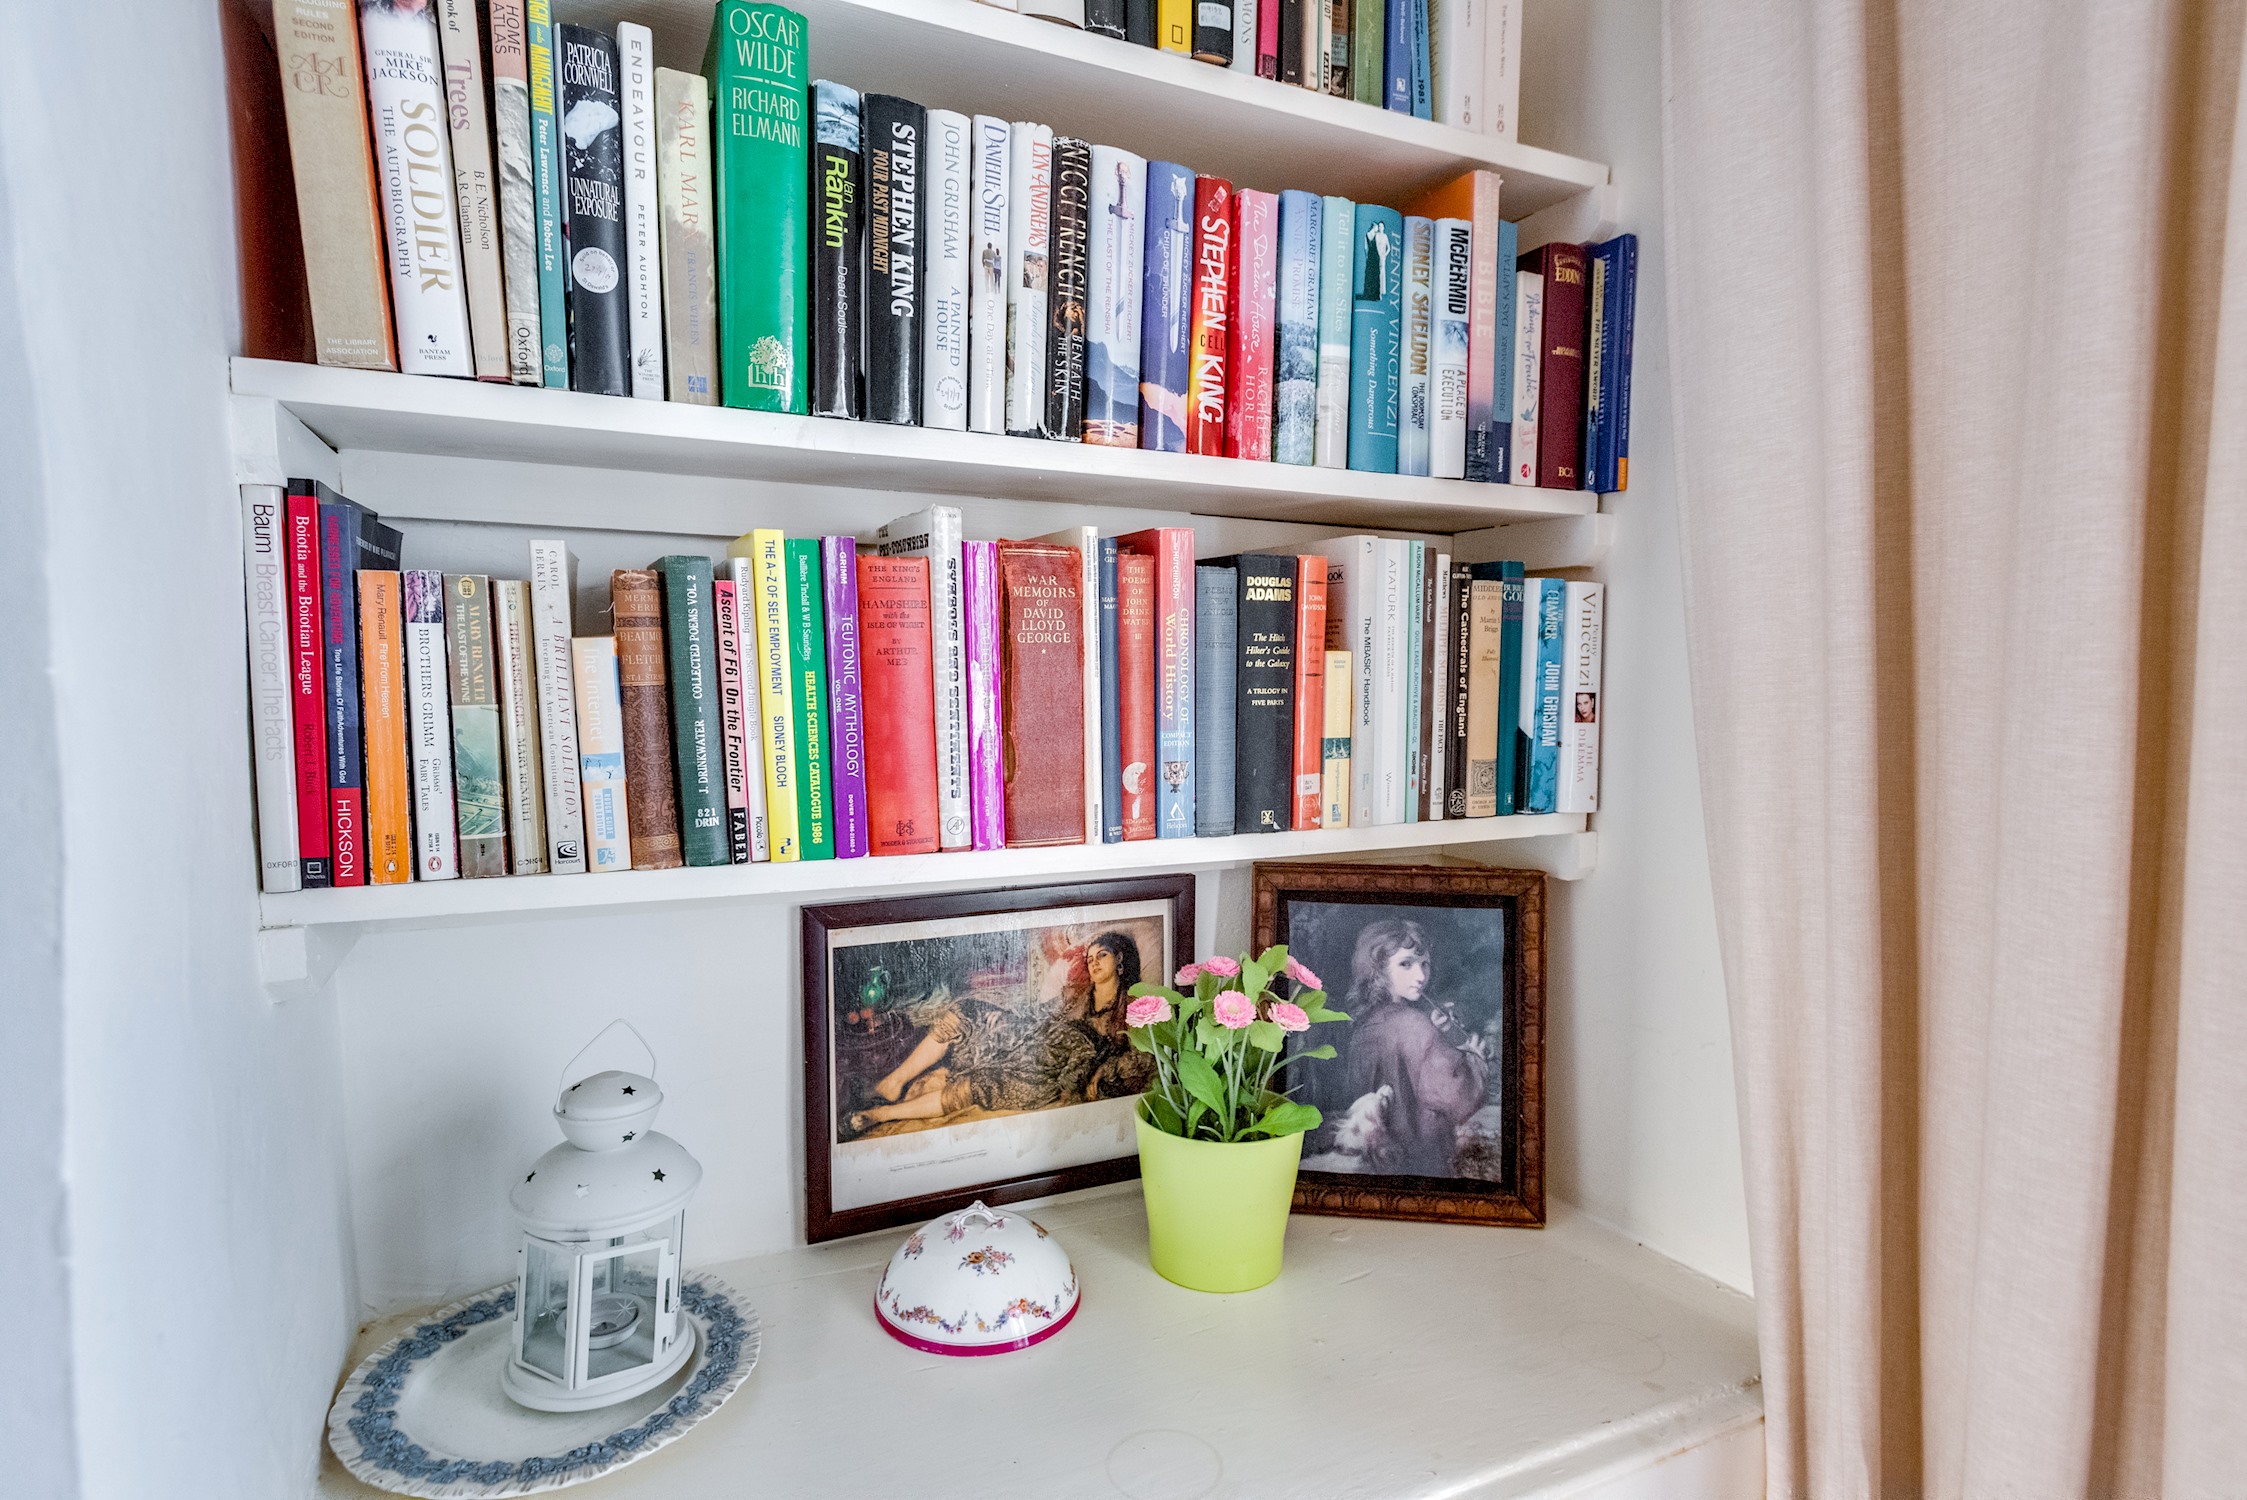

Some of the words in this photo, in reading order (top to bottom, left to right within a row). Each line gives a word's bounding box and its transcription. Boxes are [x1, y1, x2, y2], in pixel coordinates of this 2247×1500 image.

[292, 17, 334, 31] SECOND
[294, 30, 335, 43] EDITION
[492, 1, 507, 54] ATLAS
[506, 4, 521, 56] HOME
[730, 8, 799, 49] OSCAR
[372, 67, 439, 87] JACKSON
[385, 58, 424, 72] MIKE
[564, 62, 615, 95] CORNWELL
[566, 42, 612, 75] PATRICIA
[736, 39, 796, 79] WILDE
[447, 59, 472, 131] Trees
[631, 40, 645, 180] ENDEAVOUR
[732, 87, 800, 122] RICHARD
[677, 100, 697, 163] KARL
[733, 113, 800, 148] ELLMANN
[941, 121, 960, 174] JOHN
[872, 148, 889, 181] FOUR
[983, 124, 1007, 189] DANIELLE
[400, 99, 454, 295] SOLDIER
[681, 173, 700, 241] MARX
[826, 155, 849, 248] Rankin
[891, 122, 916, 248] STEPHEN
[386, 146, 412, 279] AUTOBIOGRAPHY
[460, 195, 472, 244] Clapham
[477, 196, 490, 250] Nicholson
[539, 147, 550, 195] Lawrence
[545, 253, 554, 272] Lee
[637, 204, 646, 246] PETER
[943, 178, 960, 259] GRISHAM
[1028, 173, 1050, 249] ANDREWS
[1253, 200, 1268, 232] The
[1307, 199, 1318, 266] MARGARET
[872, 219, 889, 274] MIDNIGHT
[1412, 221, 1431, 288] SIDNEY
[639, 255, 648, 319] AUGHTON
[837, 265, 848, 297] Dead
[891, 251, 915, 318] KING
[1161, 271, 1169, 318] THUNDER
[1200, 215, 1230, 331] STEPHEN
[1306, 268, 1316, 321] GRAHAM
[1389, 232, 1401, 312] PENNY
[1503, 254, 1512, 302] KAPITAL
[837, 300, 849, 334] Souls
[1104, 295, 1112, 335] RENSHAI
[1126, 298, 1134, 342] REICHERT
[1476, 260, 1494, 338] BIBLE
[1502, 303, 1511, 327] DAS
[344, 338, 377, 347] LIBRARY
[936, 299, 948, 351] HOUSE
[950, 301, 961, 367] PAINTED
[1200, 334, 1225, 352] CELL
[1410, 291, 1430, 376] SHELDON
[326, 347, 379, 356] ASSOCIATION
[517, 327, 531, 376] Oxford
[1070, 334, 1083, 401] BENEATH
[1367, 327, 1378, 377] Something
[1386, 318, 1399, 429] VINCENZI
[1054, 360, 1068, 394] SKIN
[1196, 353, 1224, 423] KING
[1244, 374, 1256, 423] HORE
[1441, 369, 1455, 421] EXECUTION
[1367, 379, 1378, 430] Dangerous
[1410, 386, 1419, 425] CONSPIRACY
[253, 504, 275, 553] Baum
[296, 515, 310, 561] Boiotia
[256, 564, 278, 616] Breast
[297, 563, 306, 578] and
[535, 548, 546, 591] BERKIN
[549, 550, 559, 590] CAROL
[741, 566, 750, 603] Rudyard
[839, 551, 848, 585] GRIMM
[868, 565, 888, 573] THE
[892, 565, 920, 573] KING'S
[872, 575, 917, 583] ENGLAND
[1028, 575, 1058, 585] WAR
[1171, 549, 1180, 599] HUTCHINSON
[1246, 576, 1292, 588] DOUGLAS
[1388, 559, 1397, 621] ATATÜRK
[377, 584, 386, 606] Mary
[456, 605, 465, 622] THE
[720, 589, 736, 636] Ascent
[801, 582, 810, 606] Tindall
[862, 600, 928, 610] HAMPSHIRE
[1013, 586, 1076, 598] MEMOIRS
[1023, 608, 1063, 619] DAVID
[1126, 598, 1148, 607] JOHN
[1246, 588, 1292, 602] ADAMS
[1461, 586, 1469, 608] The
[1544, 590, 1560, 640] CHAMBER
[299, 596, 313, 648] Boiotian
[457, 623, 466, 643] LAST
[687, 608, 700, 642] POEMS
[803, 629, 812, 661] Saunders
[1017, 632, 1071, 643] GEORGE
[1021, 620, 1066, 631] LLOYD
[1165, 613, 1177, 659] World
[1364, 617, 1372, 635] The
[1439, 607, 1448, 656] MULTIPLE
[1459, 612, 1469, 673] Cathedrals
[1579, 592, 1597, 687] Vincenzi
[1590, 624, 1599, 657] Penny
[299, 650, 315, 695] League
[379, 643, 388, 661] Fire
[380, 662, 389, 682] From
[419, 629, 433, 699] BROTHERS
[542, 638, 550, 681] Inventing
[690, 643, 703, 700] COLLECTED
[768, 627, 783, 696] EMPLOYMENT
[841, 614, 856, 685] TEUTONIC
[875, 647, 919, 656] ARTHUR
[1180, 608, 1189, 706] CHRONOLOGY
[1246, 646, 1271, 655] Hiker's
[1272, 646, 1290, 655] Guide
[471, 644, 485, 703] RENAULT
[553, 634, 571, 726] BRILLIANT
[805, 670, 817, 710] HEALTH
[1163, 664, 1177, 720] History
[1545, 661, 1561, 691] JOHN
[381, 683, 390, 718] Heaven
[546, 700, 555, 740] American
[585, 680, 602, 741] Internet
[727, 709, 741, 731] the
[1363, 679, 1372, 726] Handbook
[1456, 692, 1468, 737] England
[1541, 696, 1560, 747] GRISHAM
[422, 702, 435, 747] GRIMM
[773, 716, 785, 752] SIDNEY
[807, 711, 819, 760] SCIENCES
[844, 693, 859, 778] MYTHOLOGY
[1161, 731, 1192, 739] COMPACT
[550, 743, 559, 797] Constitution
[695, 719, 708, 784] DRINKWATER
[728, 735, 744, 792] Frontier
[775, 754, 787, 788] BLOCH
[306, 771, 315, 796] Buck
[560, 734, 577, 818] SOLUTION
[809, 761, 823, 820] CATALOGUE
[337, 800, 354, 877] HICKSON
[732, 812, 748, 861] FABER
[755, 816, 763, 839] Piccolo
[811, 822, 823, 845] 1986
[267, 859, 298, 869] OXFORD
[554, 857, 581, 866] Harcourt
